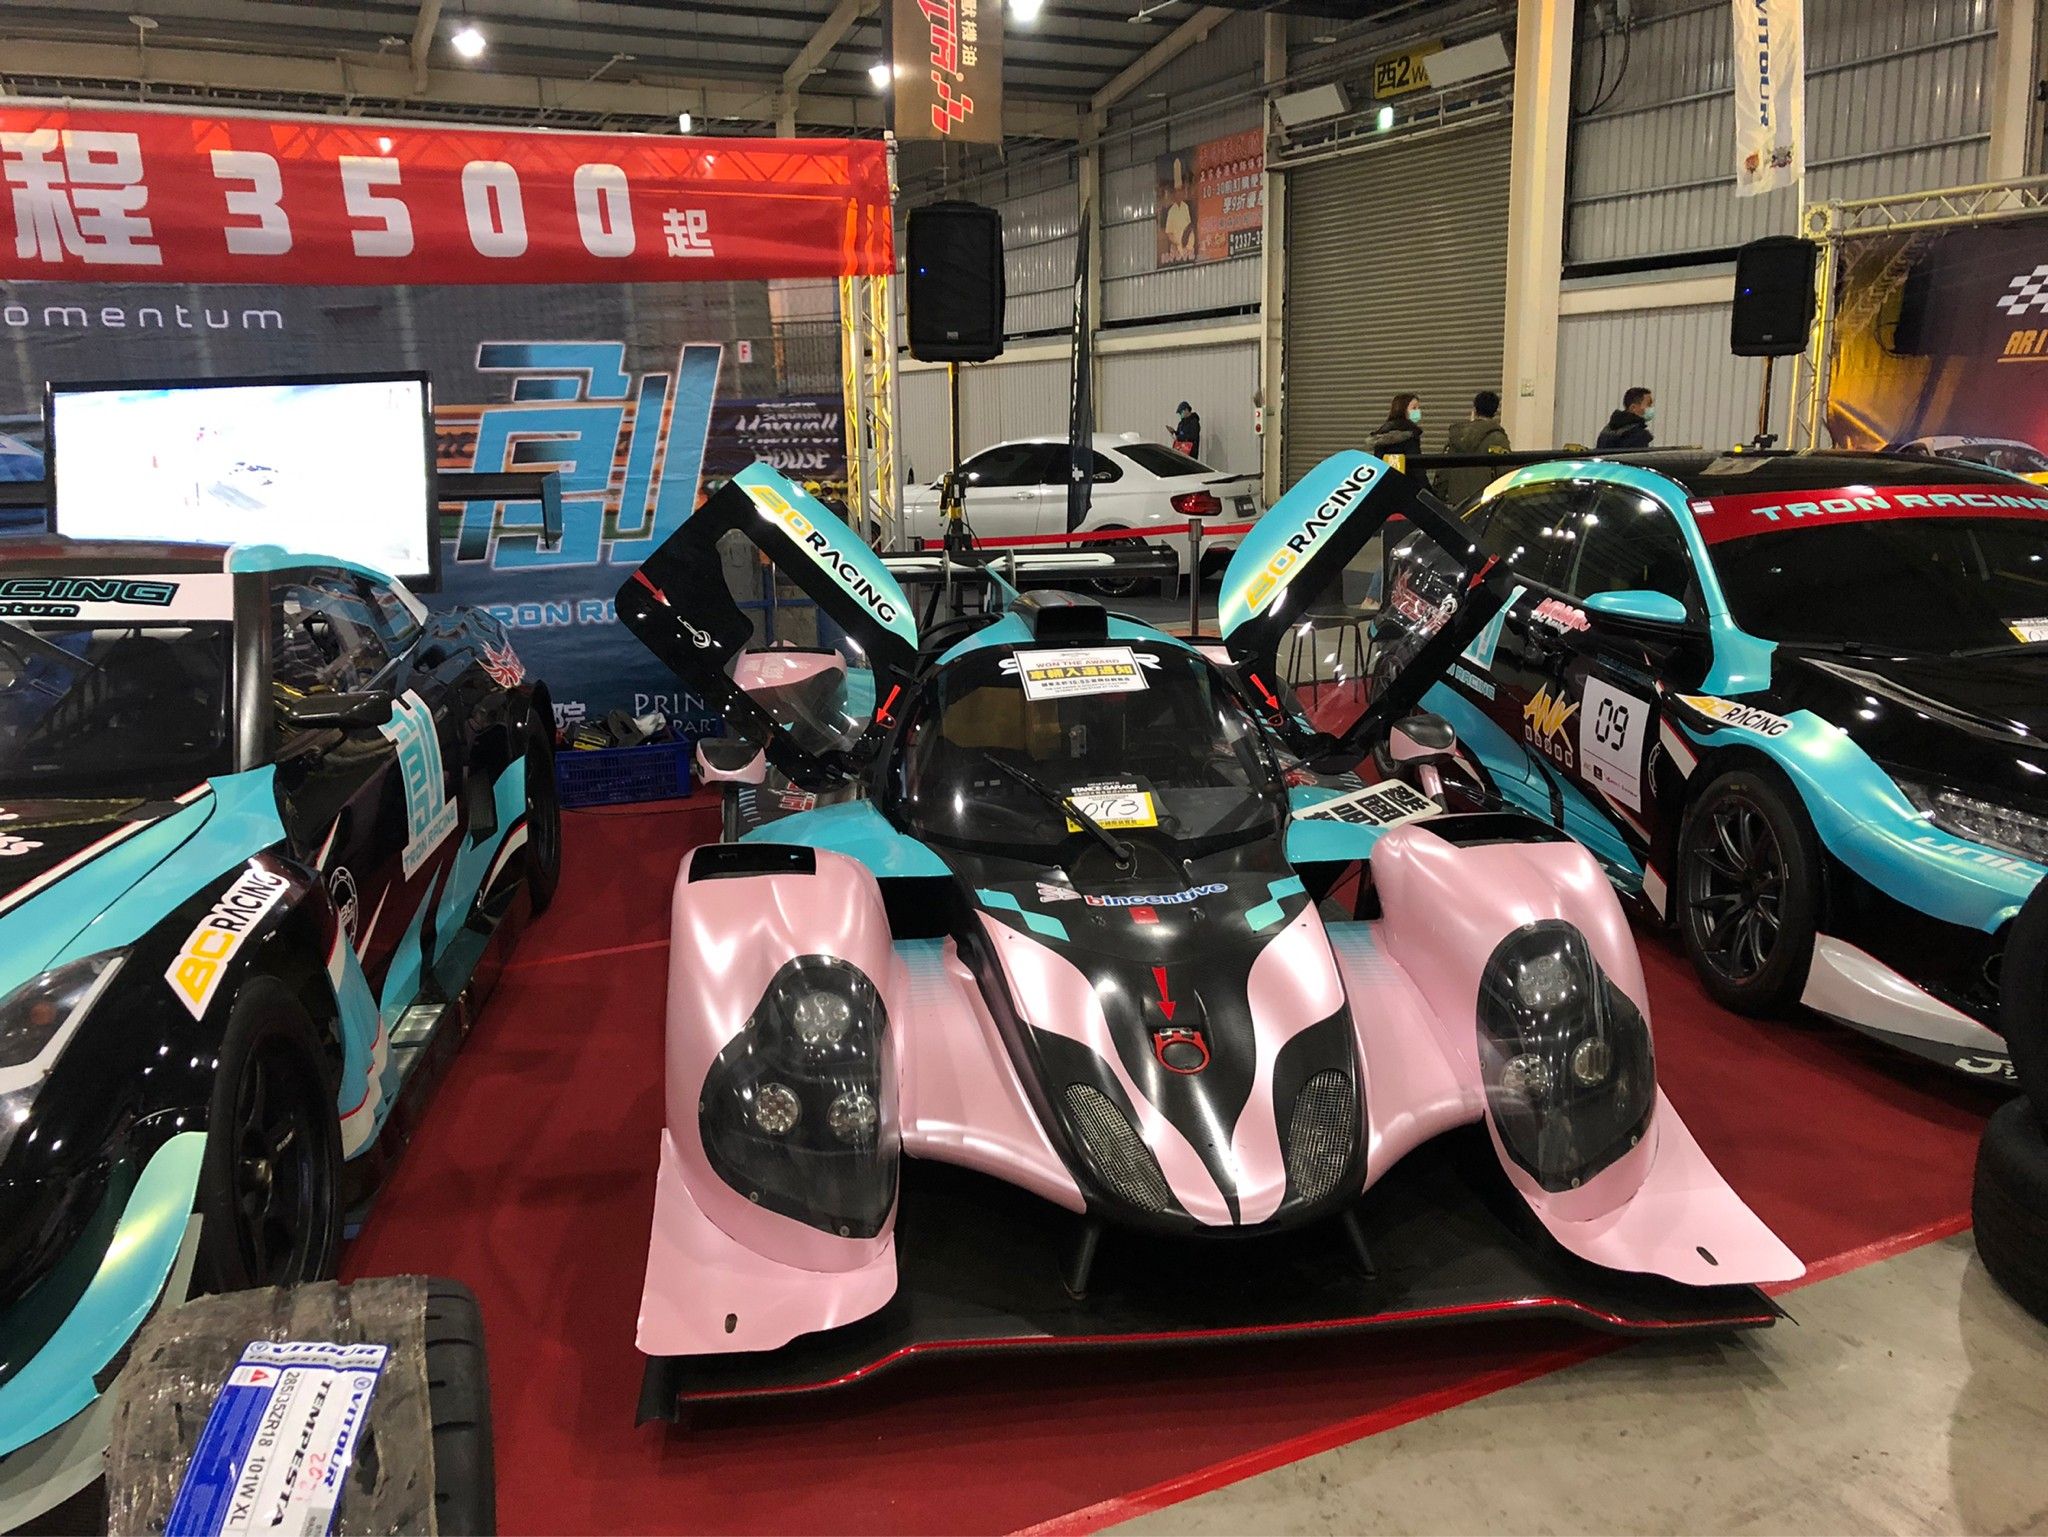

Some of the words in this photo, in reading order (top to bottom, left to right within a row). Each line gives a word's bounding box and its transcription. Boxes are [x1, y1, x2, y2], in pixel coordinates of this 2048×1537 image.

[662, 208, 715, 260] 起
[1234, 230, 1263, 250] 2337-3
[3, 304, 283, 330] omentum
[1752, 496, 1891, 521] TRON
[488, 602, 570, 628] RON
[1595, 698, 1629, 751] 09
[209, 872, 283, 933] RACING
[270, 1380, 332, 1528] TEMPESTA
[324, 1392, 363, 1488] VITOUR
[240, 1456, 266, 1499] 101W
[229, 1503, 250, 1526] XL
